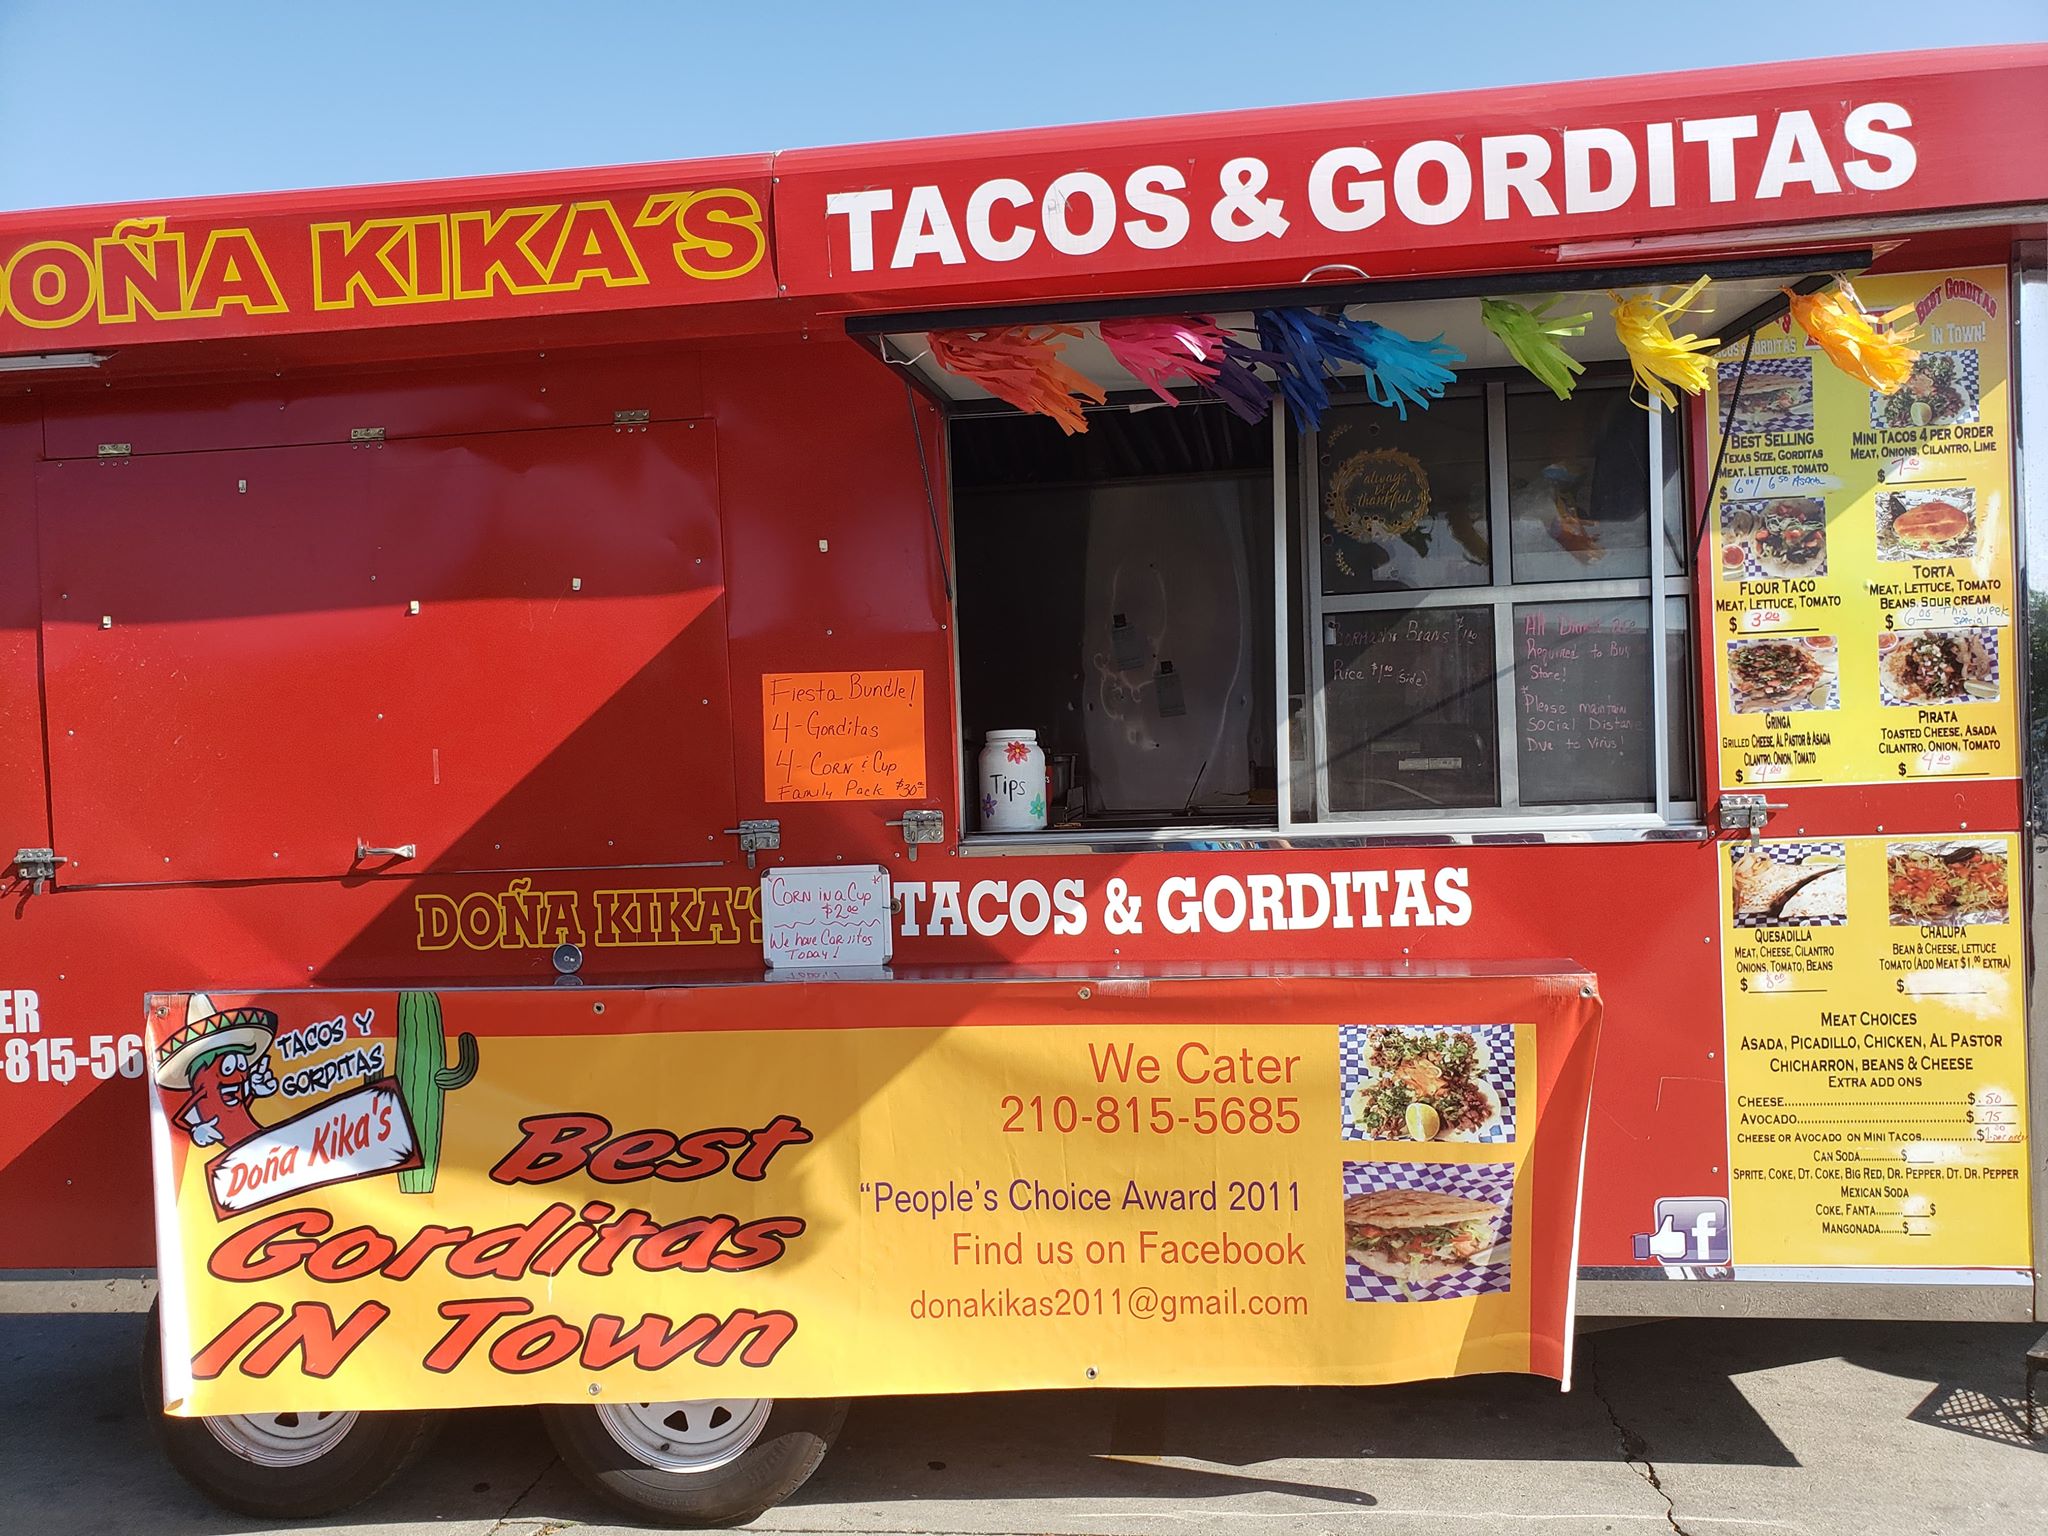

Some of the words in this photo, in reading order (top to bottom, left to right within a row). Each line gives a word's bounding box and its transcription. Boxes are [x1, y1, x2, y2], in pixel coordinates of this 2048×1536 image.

[825, 165, 1190, 272] TACOS
[1211, 157, 1290, 243] &
[1308, 102, 1918, 232] GORDITAS
[0, 218, 289, 329] OÑA
[311, 188, 765, 310] KIKA'S
[1916, 286, 1943, 325] BEST
[1946, 278, 1997, 318] GORDITAS
[1731, 434, 1761, 449] BEST
[1765, 432, 1814, 446] SELLING
[1853, 431, 1877, 446] MINI
[1879, 431, 1916, 444] TACOS
[1920, 430, 1928, 442] 4
[1931, 430, 1950, 441] PER
[1954, 427, 1993, 440] ORDER
[1974, 442, 1996, 452] LIME
[1778, 449, 1823, 461] GORDITAS
[1792, 463, 1828, 475] TOMATO
[1913, 566, 1954, 578] TORTA
[1740, 581, 1780, 595] FLOUR
[1783, 580, 1816, 593] TACO
[1958, 579, 2001, 590] TOMATO
[1798, 595, 1841, 607] TOMATO
[1921, 596, 1951, 607] SOUR
[1954, 594, 1991, 605] CREAM
[771, 678, 843, 705] Fiesta
[1765, 714, 1791, 729] GRINGA
[1918, 711, 1958, 723] PIRATA
[1881, 728, 1923, 740] TOASTED
[1966, 725, 1997, 736] ASADA
[1723, 737, 1750, 748] GRILLED
[1776, 735, 1784, 746] AL
[1785, 734, 1806, 746] PASTOR
[1807, 734, 1812, 745] &
[1812, 733, 1831, 746] ASADA
[1962, 740, 2000, 750] TOMATO
[873, 751, 897, 778] Cup
[1793, 750, 1816, 764] TOMATO
[990, 774, 1025, 802] Tips
[893, 879, 1088, 936] TACOS
[1104, 878, 1142, 935] &
[1157, 868, 1472, 933] GORDITAS
[416, 877, 586, 950] DOÑA
[1754, 929, 1812, 943] QUESADILLA
[1921, 926, 1967, 938] CHALUPA
[770, 933, 789, 948] We
[795, 932, 817, 946] have
[1795, 945, 1834, 957] CILANTRO
[1893, 944, 1915, 955] BEAN
[1917, 944, 1924, 954] &
[1962, 943, 1996, 953] LETTUCE
[1806, 960, 1833, 971] BEANS
[1880, 958, 1912, 970] TOMATO
[1936, 958, 1958, 969] MEAT
[1821, 1013, 1857, 1027] MEAT
[1860, 1012, 1917, 1025] CHOICES
[277, 1016, 345, 1060] TACOS
[354, 1008, 375, 1036] Y
[1930, 1034, 1948, 1047] AL
[1951, 1034, 2003, 1047] PASTOR
[1089, 1042, 1160, 1084] We
[1177, 1041, 1300, 1085] Cater
[1862, 1057, 1905, 1071] BEANS
[1908, 1056, 1918, 1070] &
[1920, 1057, 1973, 1070] CHEESE
[281, 1044, 384, 1099] GORDITAS
[1829, 1076, 1867, 1087] EXTRA
[1870, 1077, 1896, 1087] ADD
[1898, 1076, 1922, 1086] ONS
[1001, 1095, 1300, 1134] 210-815-5685
[1737, 1133, 1776, 1143] CHEESE
[1778, 1133, 1792, 1142] OR
[1794, 1132, 1842, 1143] AVOCADO
[1847, 1133, 1861, 1142] ON
[1863, 1132, 1886, 1142] MINI
[227, 1145, 296, 1198] Doña
[308, 1095, 393, 1168] Kika's
[490, 1111, 814, 1186] Best
[1814, 1150, 1833, 1162] CAN
[1845, 1168, 1861, 1179] BIG
[1983, 1168, 2019, 1179] PEPPER
[1009, 1178, 1111, 1211] Choice
[1122, 1180, 1217, 1211] Award
[1229, 1181, 1299, 1211] 2011
[1840, 1186, 1882, 1198] MEXICAN
[1884, 1186, 1909, 1198] SODA
[208, 1199, 806, 1283] Gorditas
[953, 1231, 1022, 1265] Find
[1036, 1241, 1073, 1265] us
[1086, 1240, 1124, 1264] on
[1140, 1230, 1306, 1265] Facebook
[910, 1286, 1308, 1322] donakikas2011@gmail.com
[191, 1300, 390, 1379] IN
[422, 1296, 799, 1374] Town
